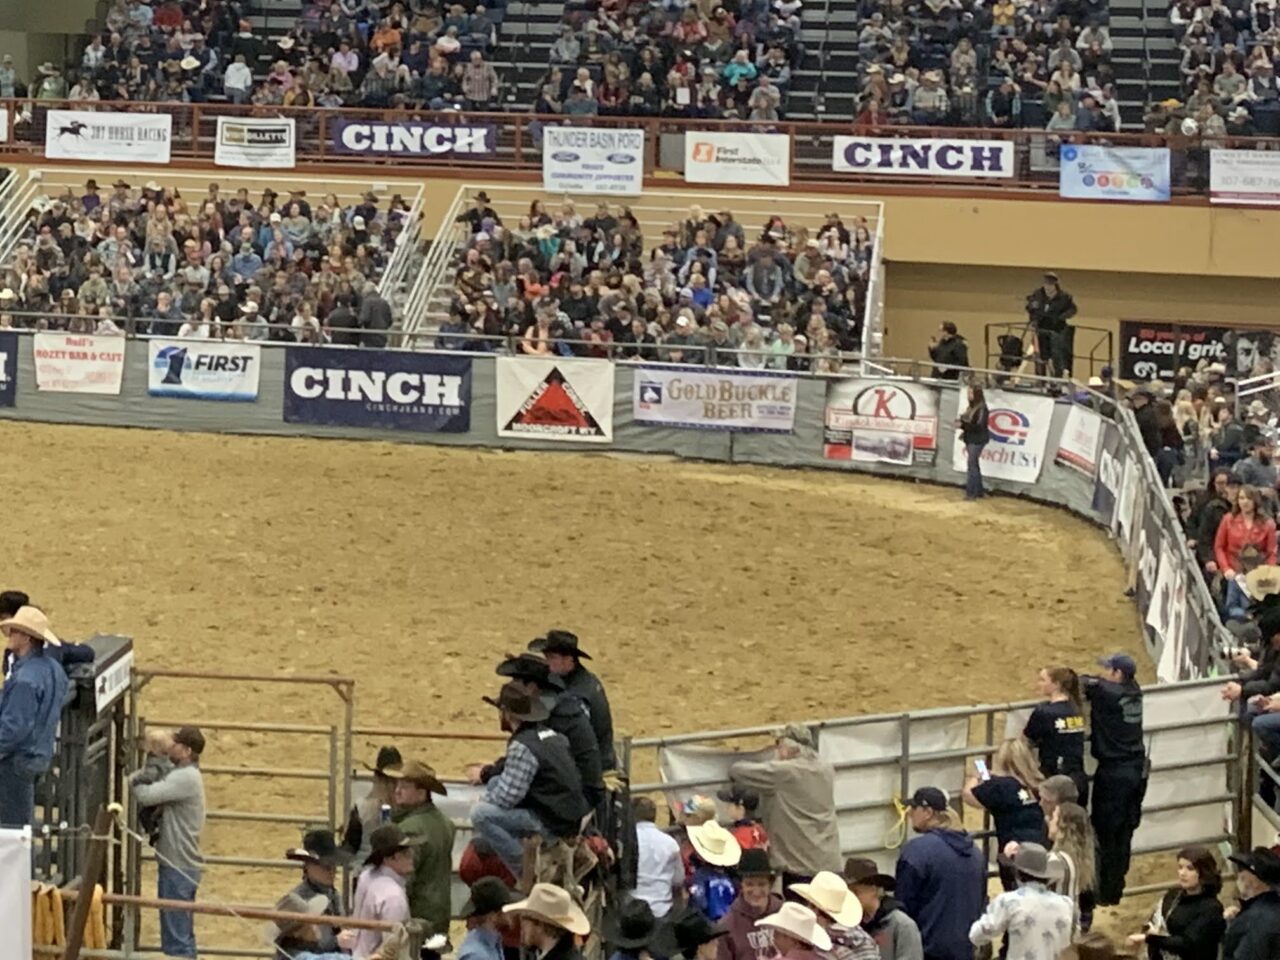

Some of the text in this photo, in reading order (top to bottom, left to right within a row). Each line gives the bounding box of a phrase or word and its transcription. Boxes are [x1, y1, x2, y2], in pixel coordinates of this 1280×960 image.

[342, 124, 489, 153] CINCH
[548, 130, 588, 149] THUNDER
[590, 131, 616, 150] BASIN
[843, 141, 1004, 172] CINCH
[36, 350, 66, 359] ROZET
[68, 351, 88, 360] BAR
[194, 353, 253, 373] FIRST
[290, 367, 462, 406] CINCH
[703, 402, 753, 419] BEER
[874, 389, 897, 420] K
